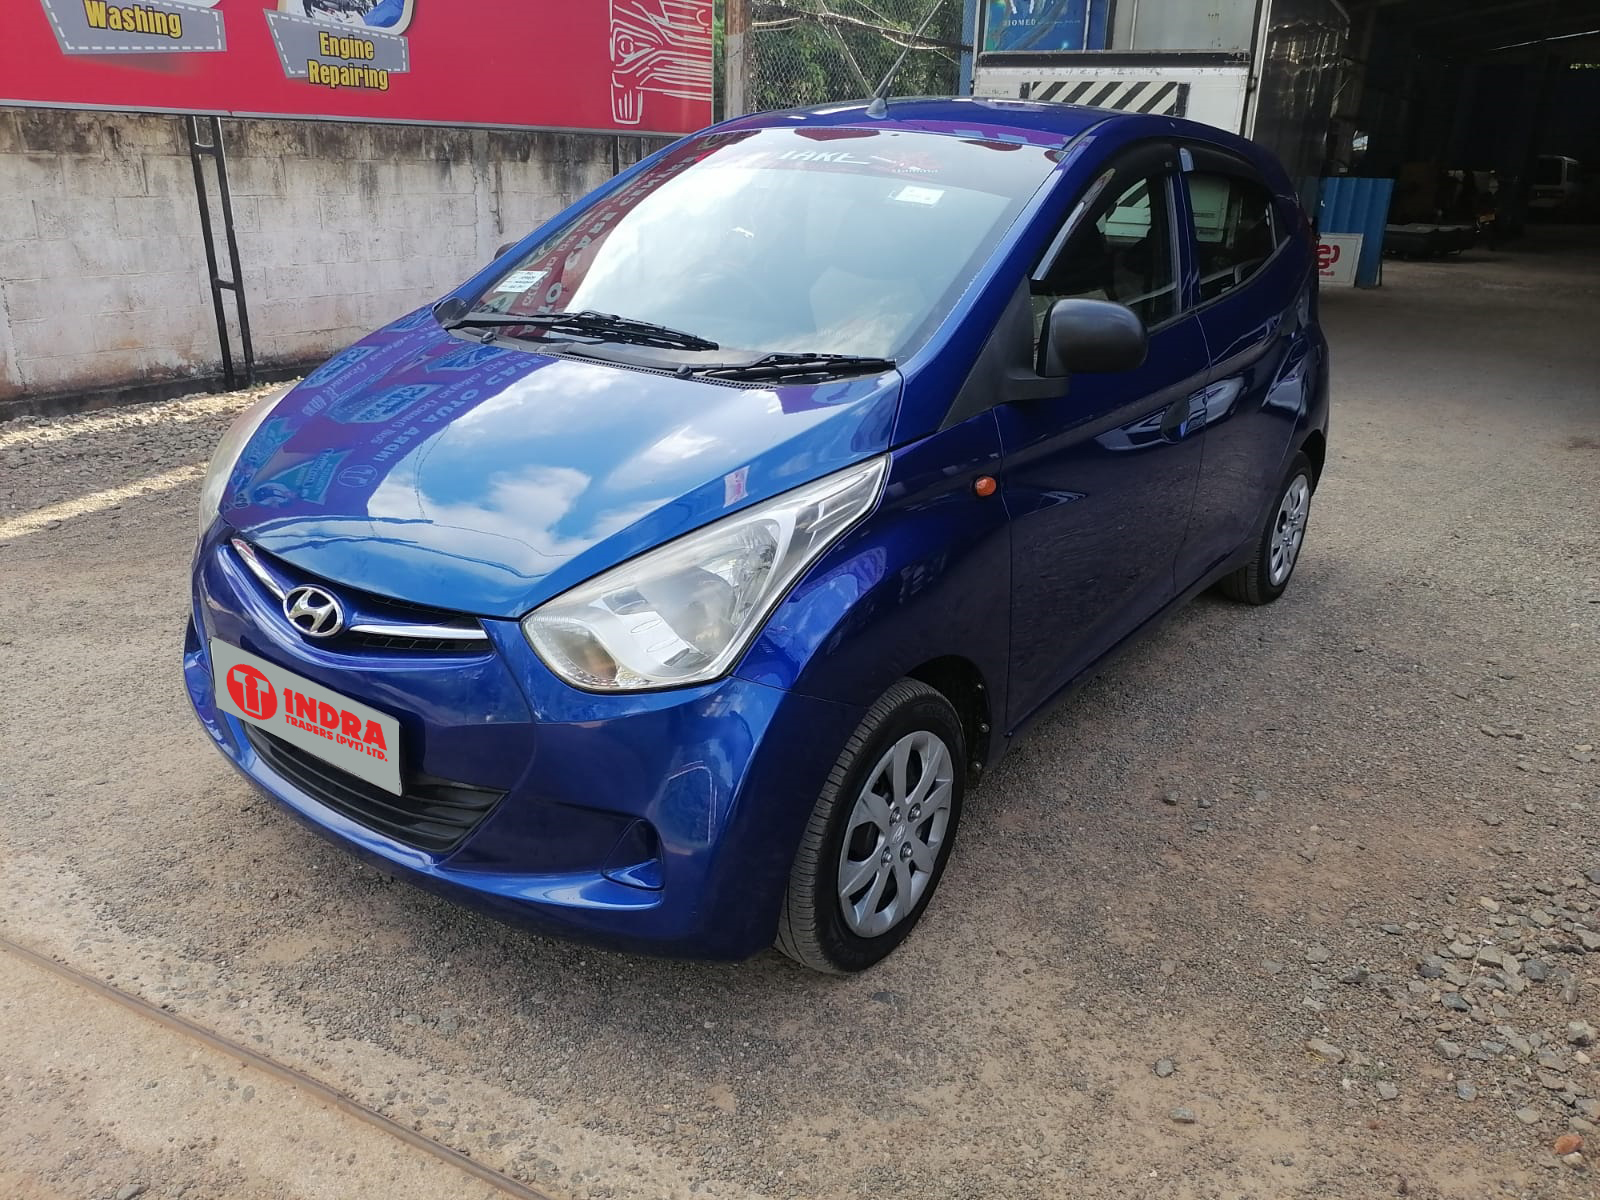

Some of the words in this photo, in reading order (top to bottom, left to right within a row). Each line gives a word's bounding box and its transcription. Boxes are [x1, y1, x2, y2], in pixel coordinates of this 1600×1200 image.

[83, 0, 182, 38] Washing
[319, 31, 375, 60] Engine
[307, 59, 390, 91] Repairing
